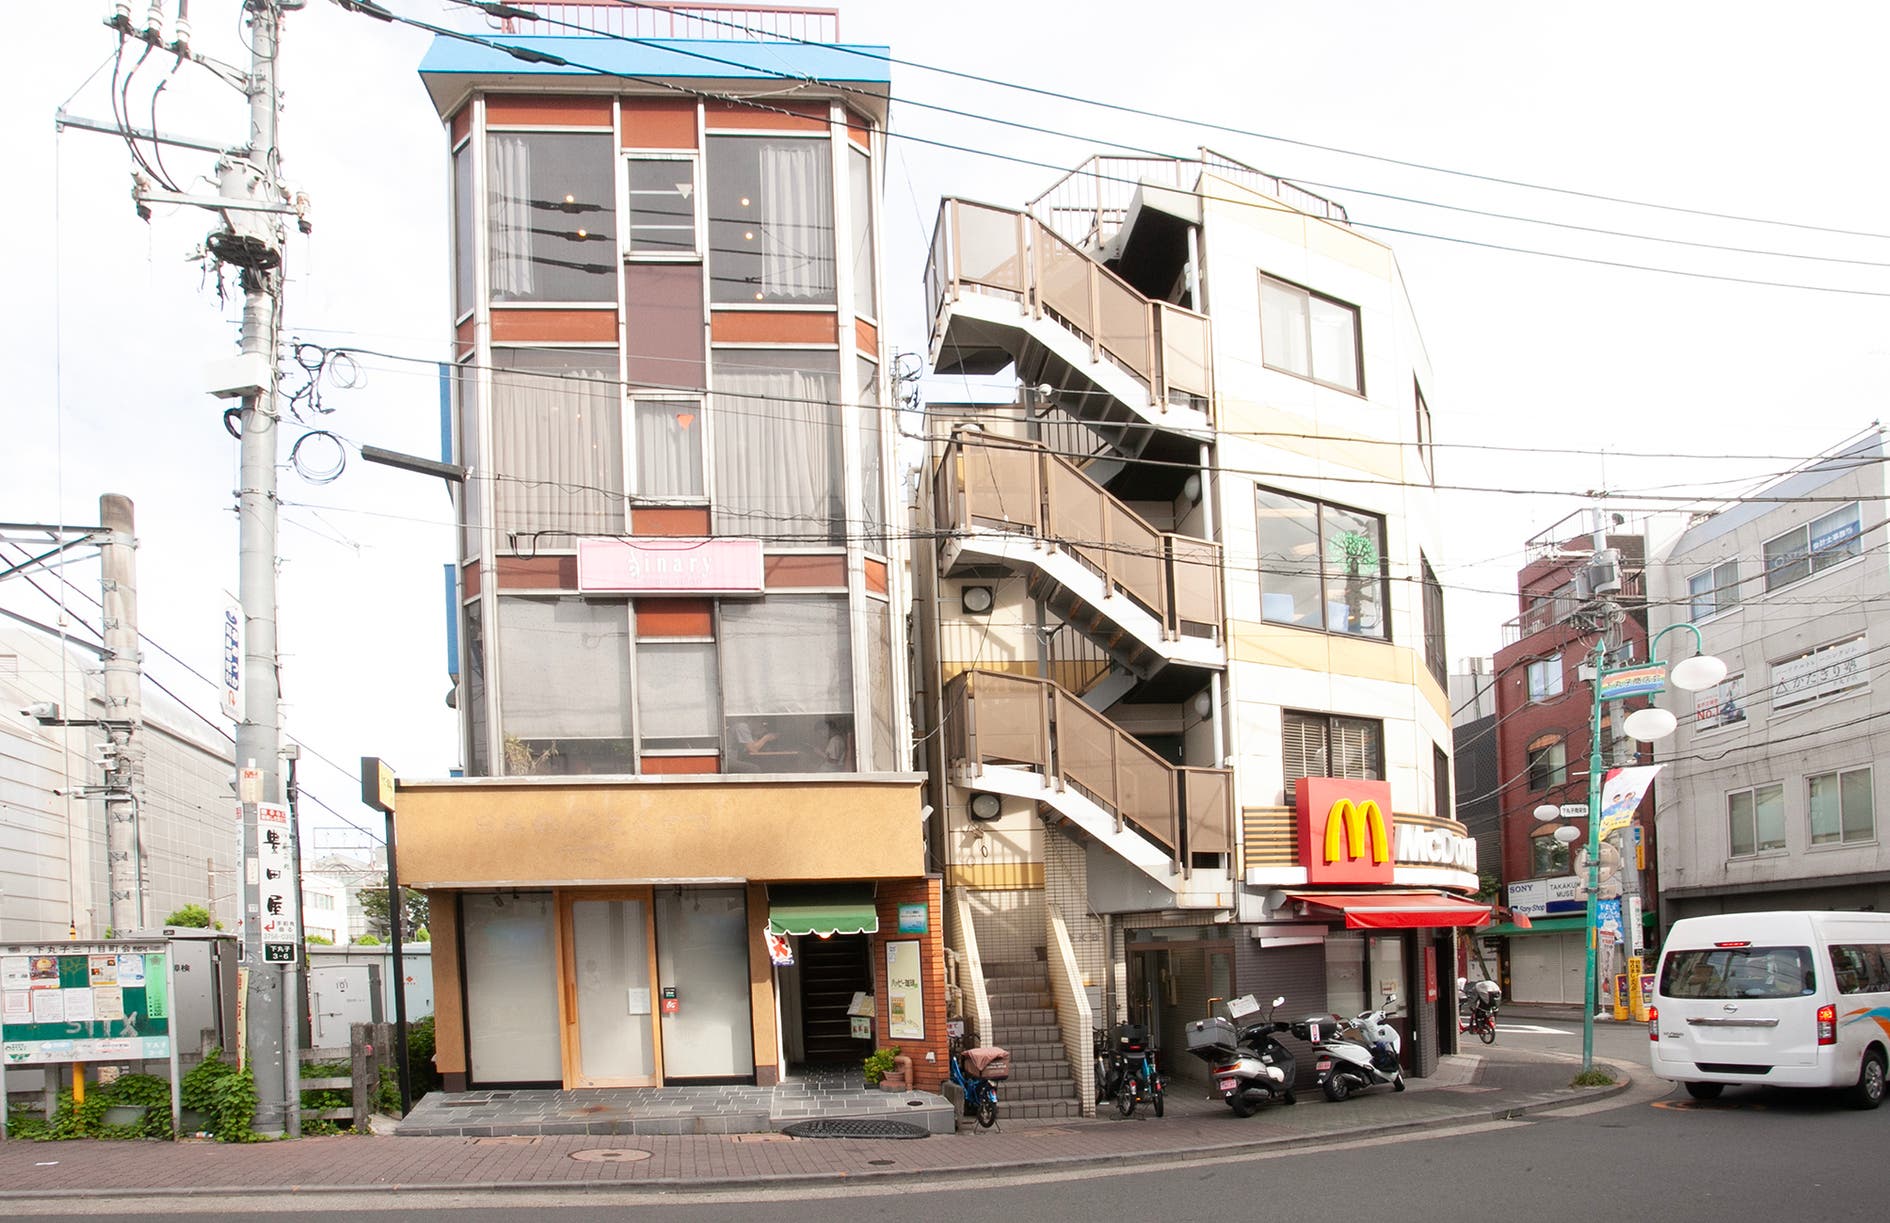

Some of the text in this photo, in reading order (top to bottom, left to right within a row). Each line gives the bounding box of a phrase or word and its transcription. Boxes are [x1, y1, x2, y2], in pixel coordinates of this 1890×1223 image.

[1509, 884, 1533, 894] SONY
[1532, 904, 1545, 912] Shop
[37, 944, 132, 953] 下丸子三丁目町会
[269, 944, 290, 952] 下丸子
